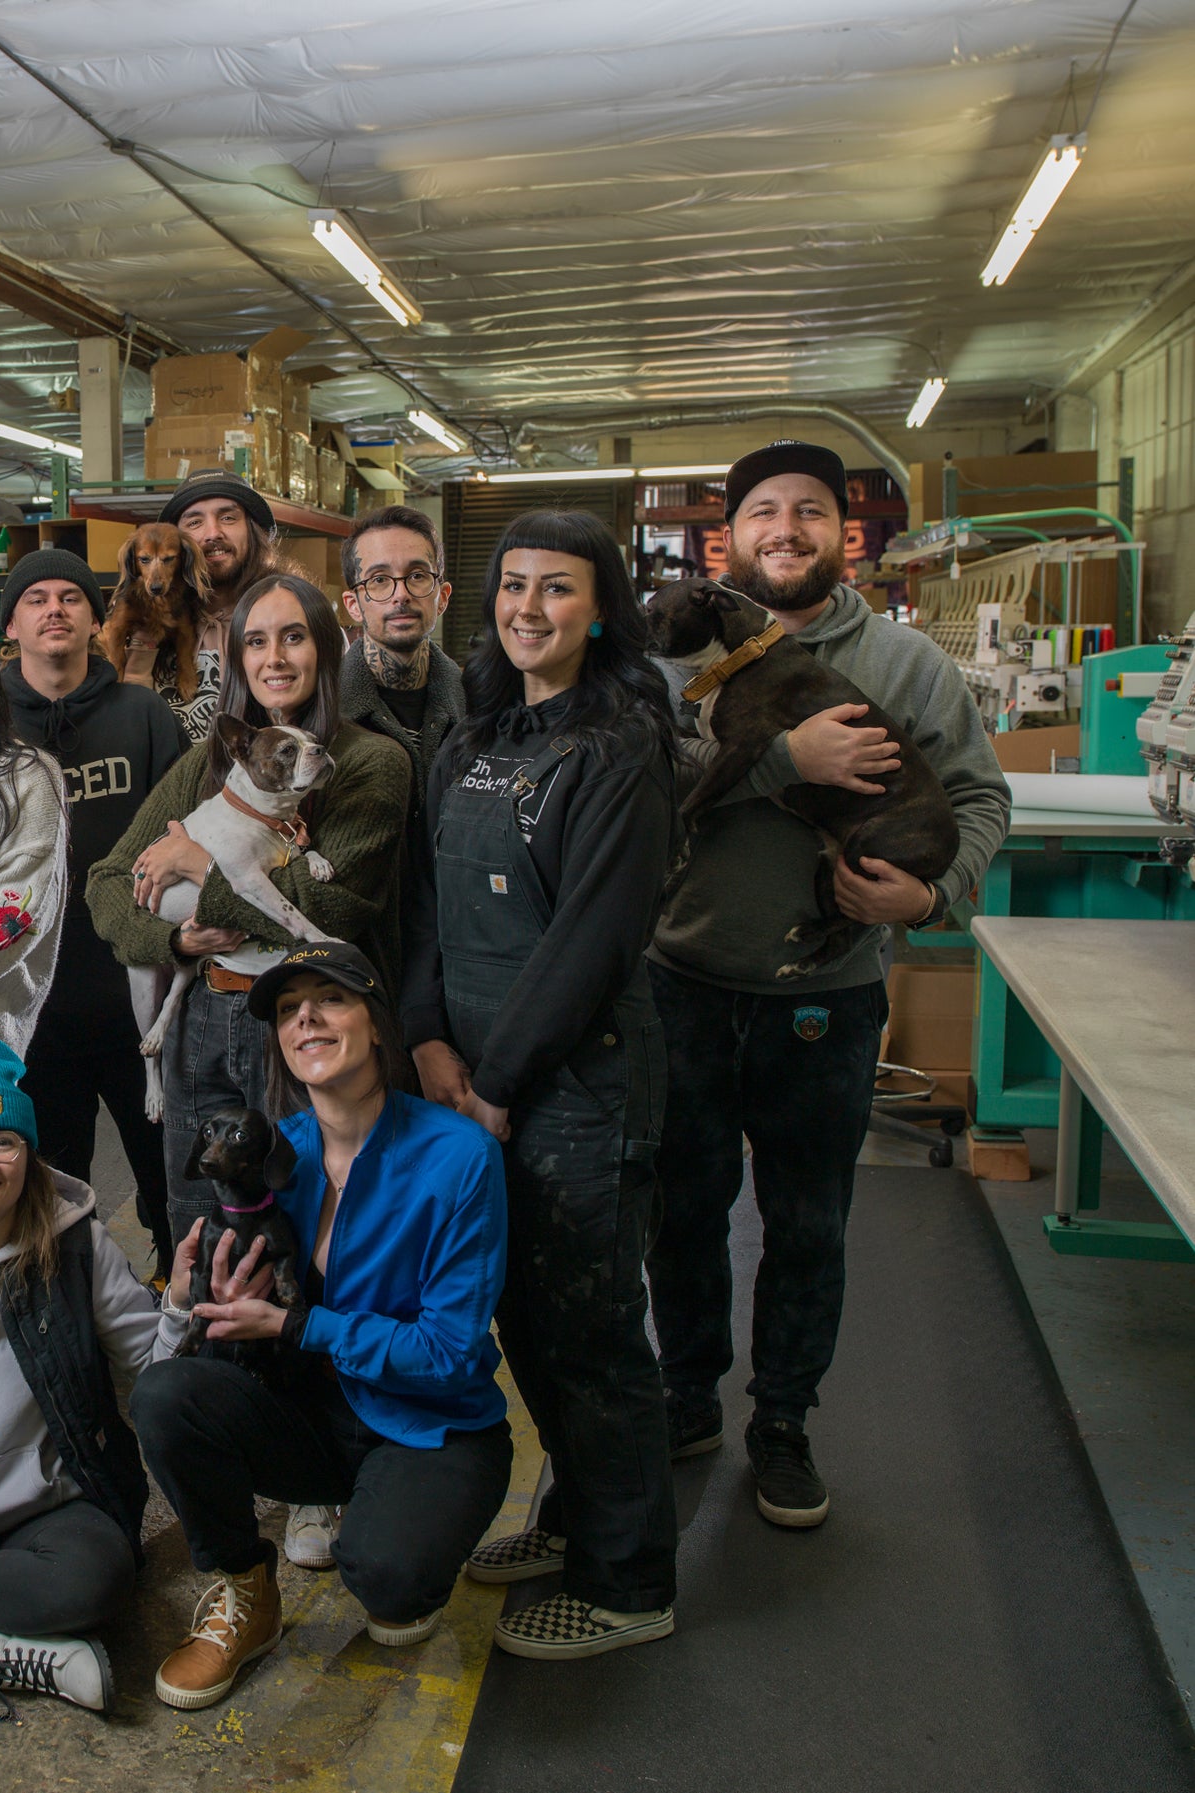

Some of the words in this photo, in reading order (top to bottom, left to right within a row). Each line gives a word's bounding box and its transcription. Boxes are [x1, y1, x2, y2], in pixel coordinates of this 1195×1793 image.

[62, 756, 132, 803] CED
[284, 949, 330, 964] NDLAY
[797, 1009, 827, 1017] FINDLAY
